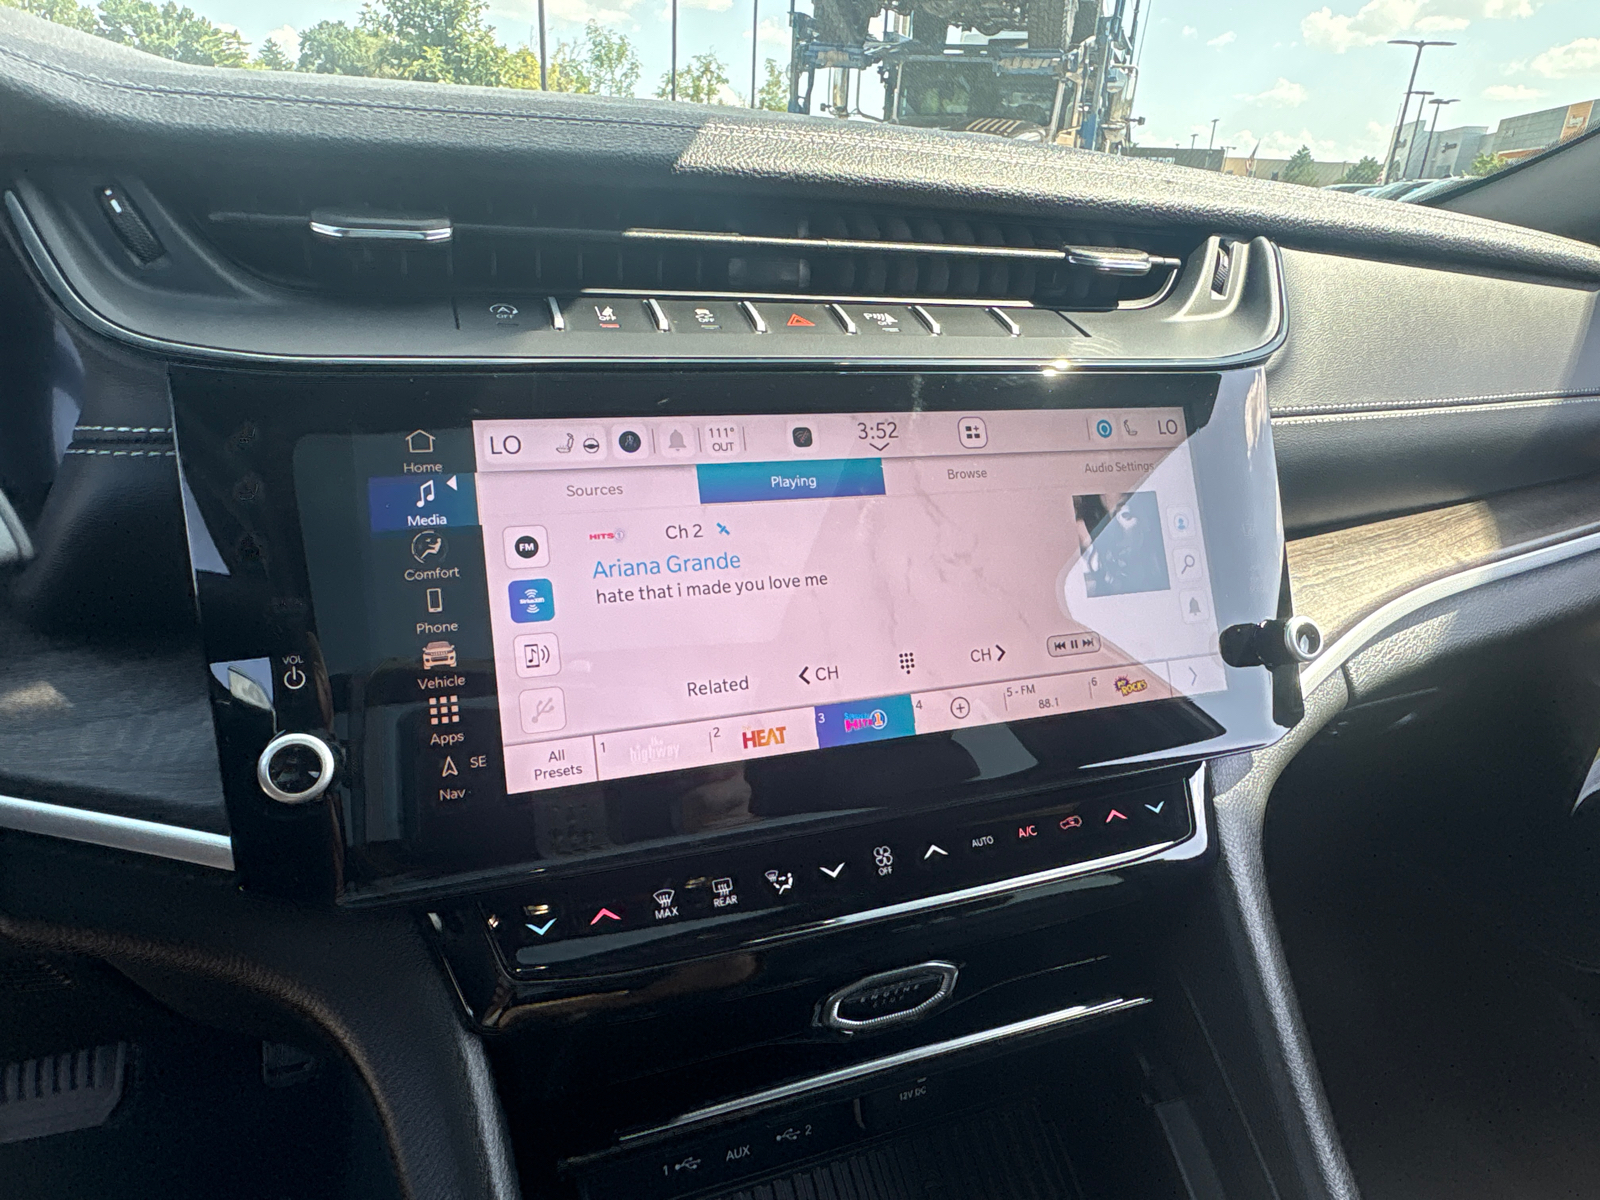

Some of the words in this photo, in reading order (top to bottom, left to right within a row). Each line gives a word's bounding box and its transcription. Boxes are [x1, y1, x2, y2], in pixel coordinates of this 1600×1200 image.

[857, 421, 899, 440] 3:52
[1158, 418, 1178, 435] LO
[490, 434, 522, 456] LO
[712, 441, 734, 453] OUT
[403, 461, 443, 473] Home
[1084, 460, 1113, 474] Audio
[1115, 458, 1155, 474] Settings
[947, 466, 988, 481] Browse
[771, 474, 817, 491] Playing
[566, 482, 624, 498] Sources
[407, 514, 448, 526] Media
[665, 525, 691, 540] Ch
[693, 524, 703, 539] 2
[518, 542, 535, 552] FM
[593, 559, 661, 579] Ariana
[666, 551, 741, 574] Grande
[404, 566, 461, 581] Comfort
[596, 586, 634, 604] hate
[638, 583, 672, 601] that
[676, 582, 682, 598] i
[686, 577, 731, 597] made
[735, 578, 765, 597] you
[768, 573, 801, 591] love
[805, 573, 828, 588] me
[416, 620, 459, 634] Phone
[282, 655, 304, 665] VOL
[970, 648, 991, 664] CH
[815, 665, 839, 681] CH
[417, 675, 466, 690] Vehicle
[688, 675, 750, 697] Related
[1091, 676, 1098, 687] 6
[1007, 687, 1014, 697] 5
[1020, 684, 1036, 696] FM
[915, 699, 923, 709] 4
[1039, 697, 1060, 709] 88.1
[818, 713, 826, 724] 3
[430, 731, 465, 747] Apps
[713, 727, 721, 738] 2
[742, 725, 787, 750] HEAT
[600, 741, 606, 754] 1
[629, 744, 680, 763] highway
[470, 755, 488, 768] SE
[548, 749, 566, 762] All
[534, 763, 582, 781] Presets
[439, 788, 466, 801] Nav
[1018, 825, 1038, 839] A/C
[972, 836, 994, 848] AUTO
[878, 865, 894, 877] OFF
[713, 894, 738, 908] REAR
[655, 906, 679, 920] MAX
[899, 1089, 914, 1101] 12V
[805, 1124, 813, 1136] 2
[725, 1145, 751, 1162] AUX
